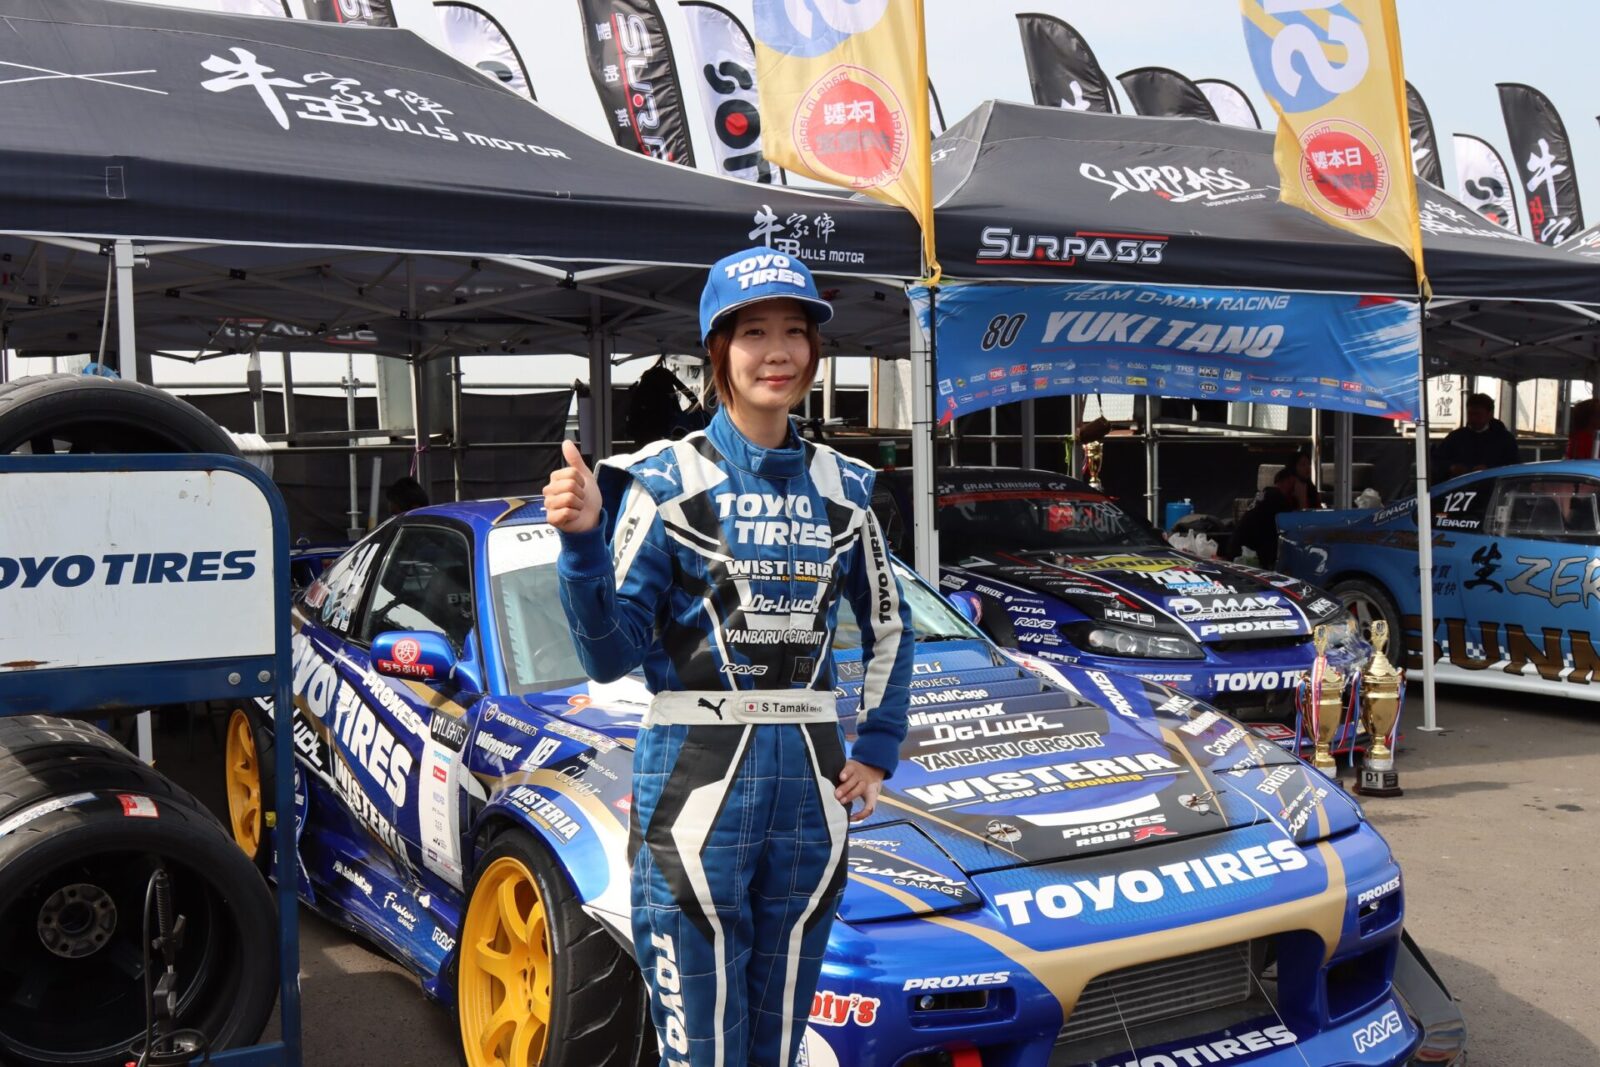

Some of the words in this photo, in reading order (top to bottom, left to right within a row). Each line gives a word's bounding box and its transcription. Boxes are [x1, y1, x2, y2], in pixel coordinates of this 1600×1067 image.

[463, 131, 572, 161] MOTOR
[1078, 162, 1251, 201] SURPASS
[828, 250, 866, 264] MOTOR
[977, 226, 1168, 265] SURPASS
[724, 254, 791, 279] TOYO
[737, 268, 806, 290] TIRES
[1064, 289, 1131, 305] TEAM
[1136, 291, 1212, 309] D-MAX
[1219, 294, 1291, 313] RACING
[980, 312, 1027, 351] 80
[1040, 311, 1162, 346] YUKI
[1168, 319, 1287, 359] TANO
[715, 492, 813, 519] TOYO
[1443, 491, 1477, 513] 127
[734, 520, 834, 548] TIRES
[1435, 512, 1480, 529] TENACITY
[865, 510, 885, 571] TIRES
[102, 550, 257, 586] TIRES
[878, 572, 892, 625] TOYO
[975, 584, 1005, 599] BRIDE
[1014, 617, 1056, 630] RAYS
[1106, 609, 1153, 625] HKS
[1200, 620, 1299, 637] PROXES
[724, 628, 783, 645] YANBARU
[719, 662, 769, 676] RAYS
[1214, 671, 1281, 692] TOYO
[362, 670, 423, 735] PROXES
[333, 679, 414, 808] TIRES
[912, 745, 1021, 774] YANBARU
[1018, 731, 1105, 758] CIRCUIT
[904, 752, 1181, 807] WISTERIA
[982, 787, 1038, 804] Keep
[1038, 782, 1066, 795] on
[1066, 773, 1145, 791] Evolving
[509, 785, 582, 840] WISTERIA
[1061, 814, 1167, 840] PROXES
[892, 878, 963, 898] GARAGE
[993, 868, 1165, 927] TOYO
[1158, 839, 1309, 894] TIRES
[1357, 876, 1401, 905] PROXES
[902, 971, 1011, 992] PROXES
[1171, 1025, 1298, 1067] TIRES
[1352, 1010, 1403, 1054] RAYS
